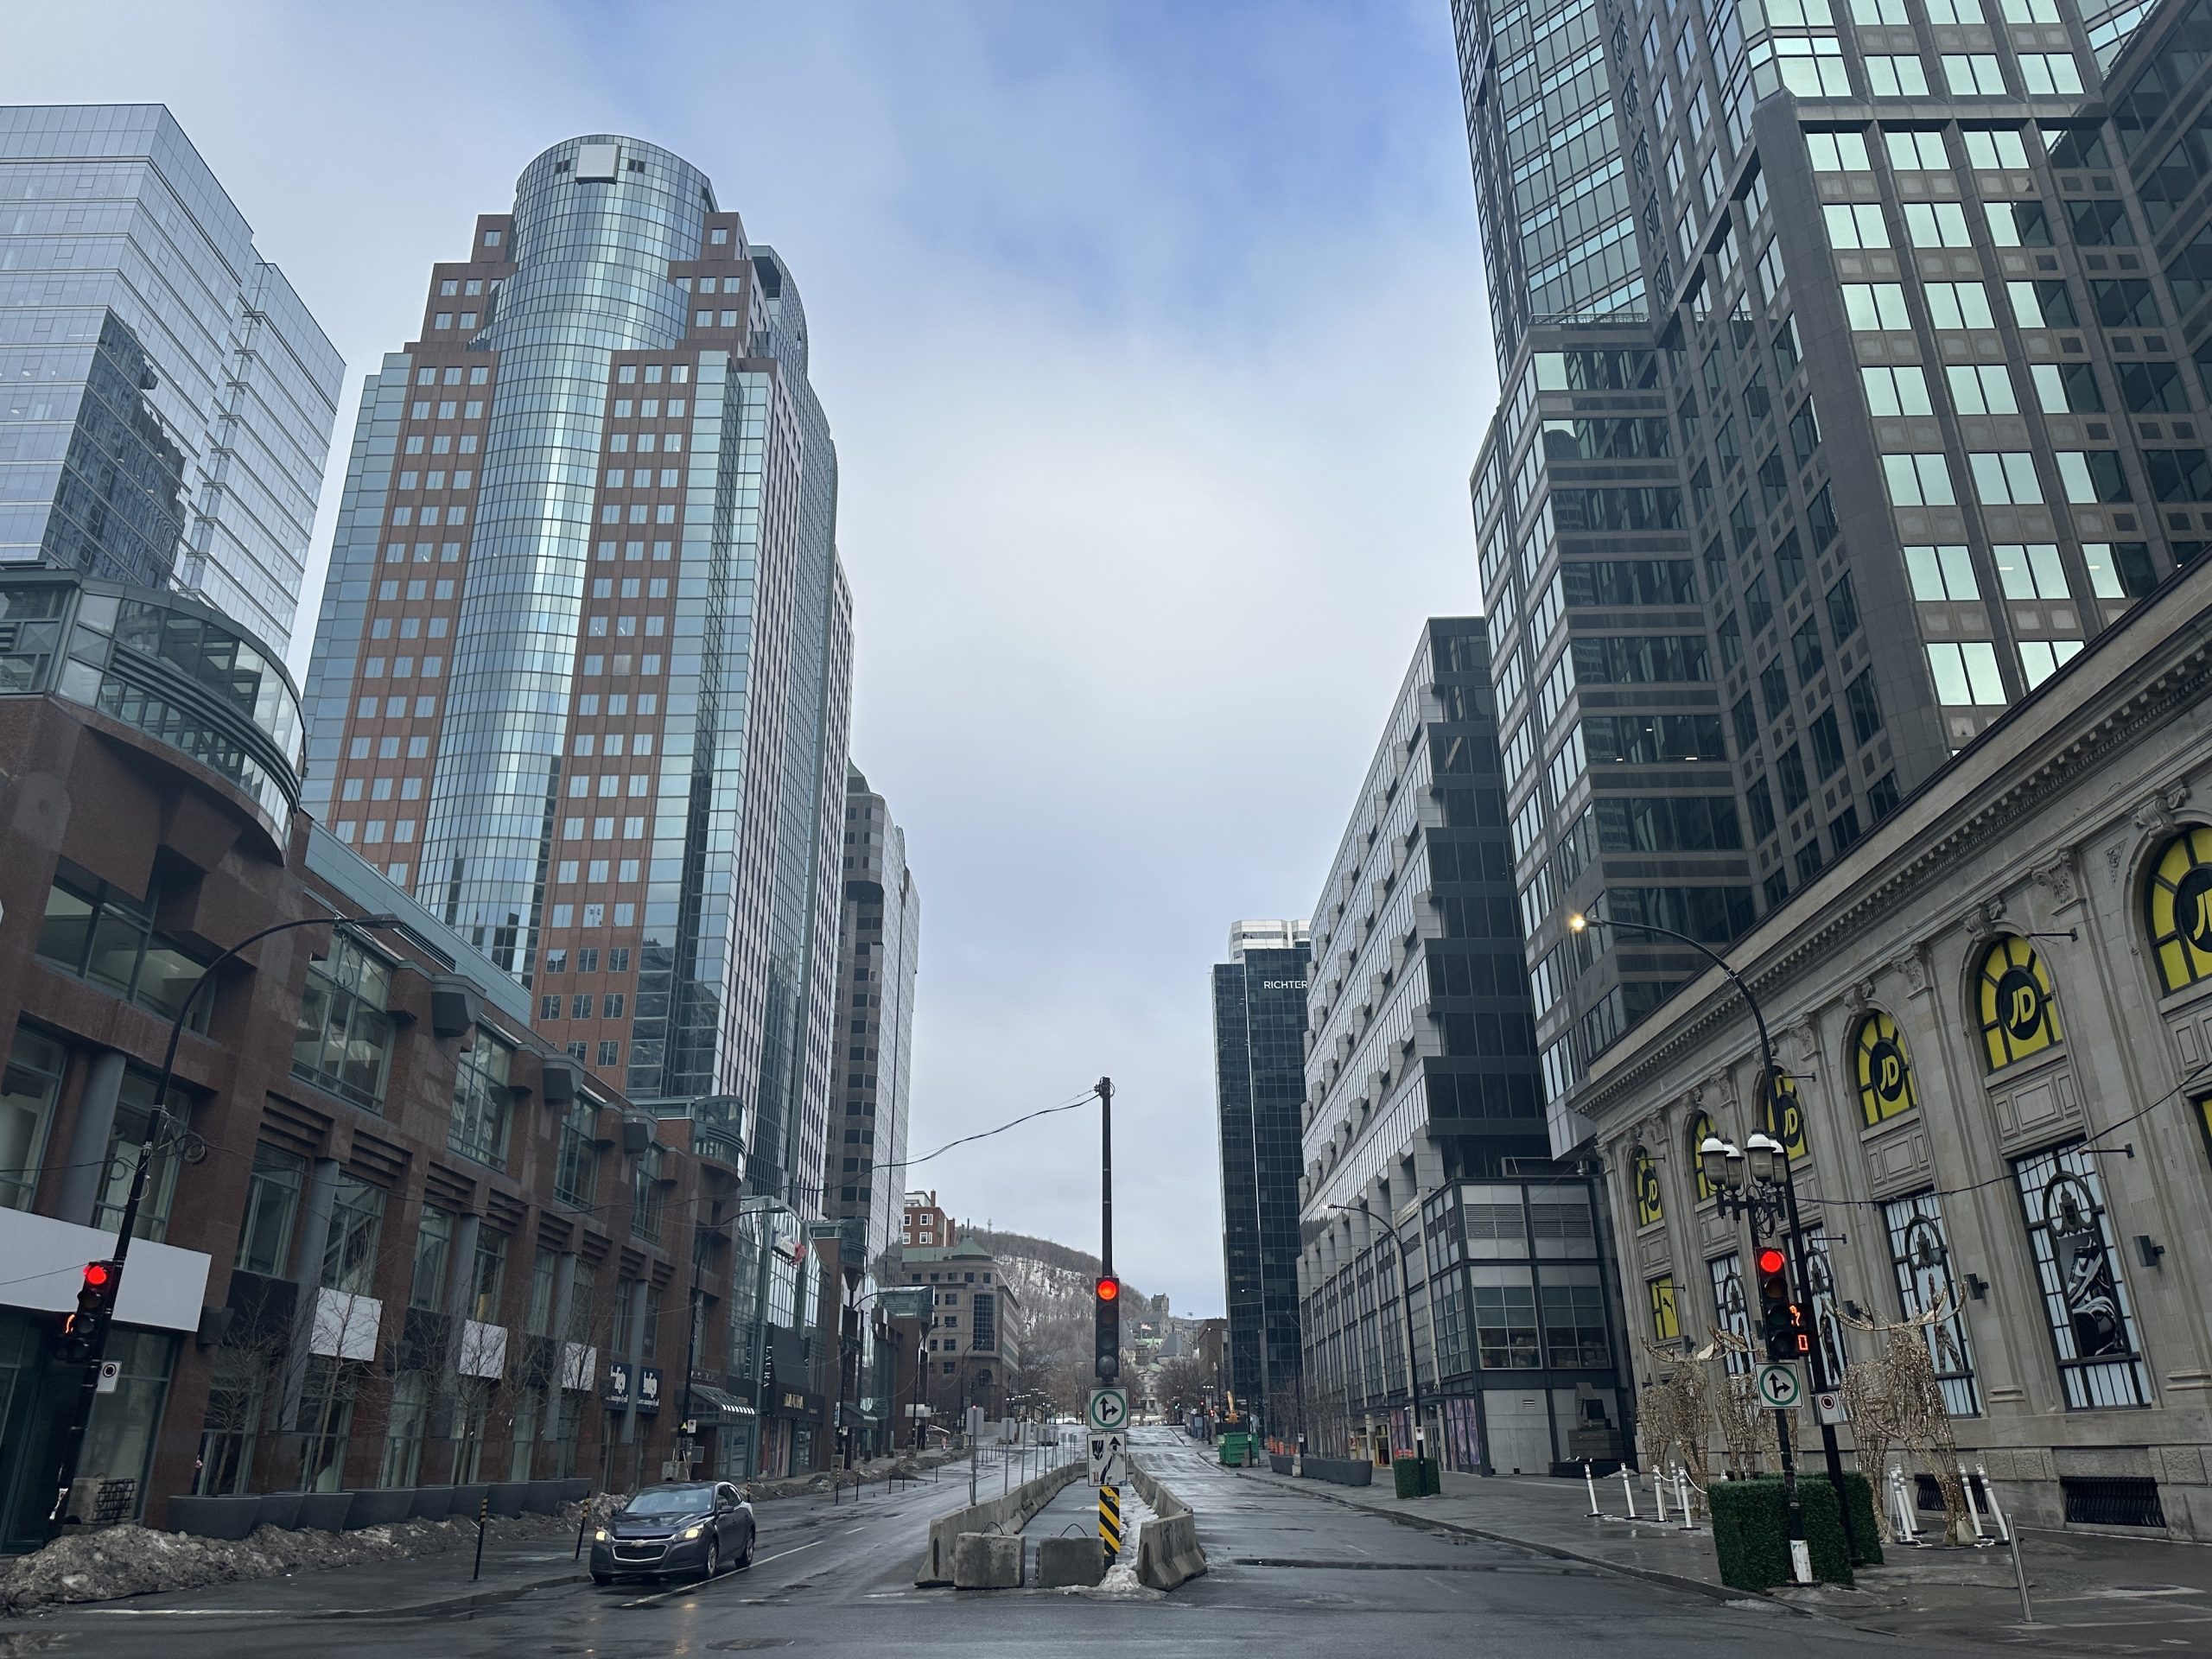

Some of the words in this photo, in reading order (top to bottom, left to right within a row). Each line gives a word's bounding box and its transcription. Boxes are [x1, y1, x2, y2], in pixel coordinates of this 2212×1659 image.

[1263, 980, 1307, 989] RICHTER
[2010, 986, 2036, 1029] JD
[1880, 1055, 1899, 1091] JD
[1783, 1107, 1797, 1138] JD
[1647, 1179, 1658, 1204] JD
[763, 1344, 773, 1388] LAURA
